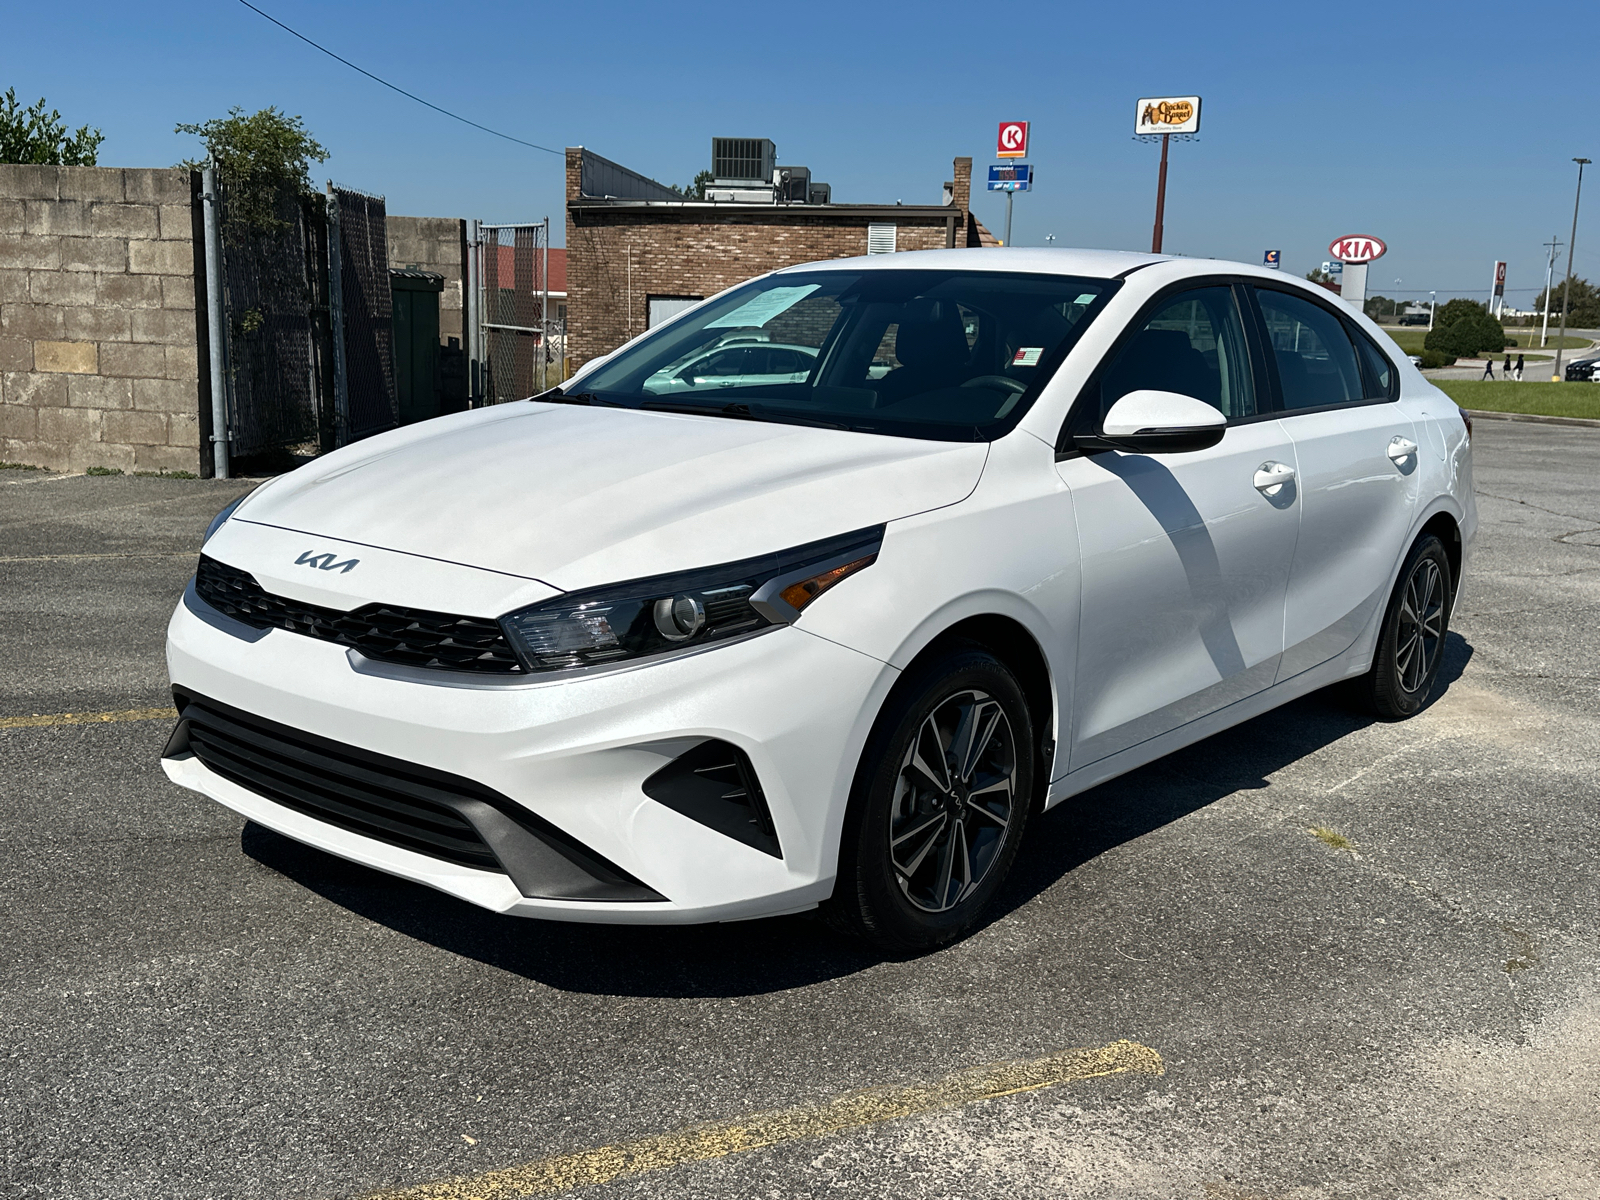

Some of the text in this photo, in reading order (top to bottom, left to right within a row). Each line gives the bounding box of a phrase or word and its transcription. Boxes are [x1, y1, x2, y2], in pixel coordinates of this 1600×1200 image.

[1164, 111, 1190, 123] Barrel
[1007, 130, 1020, 145] K
[1339, 241, 1375, 259] KIA
